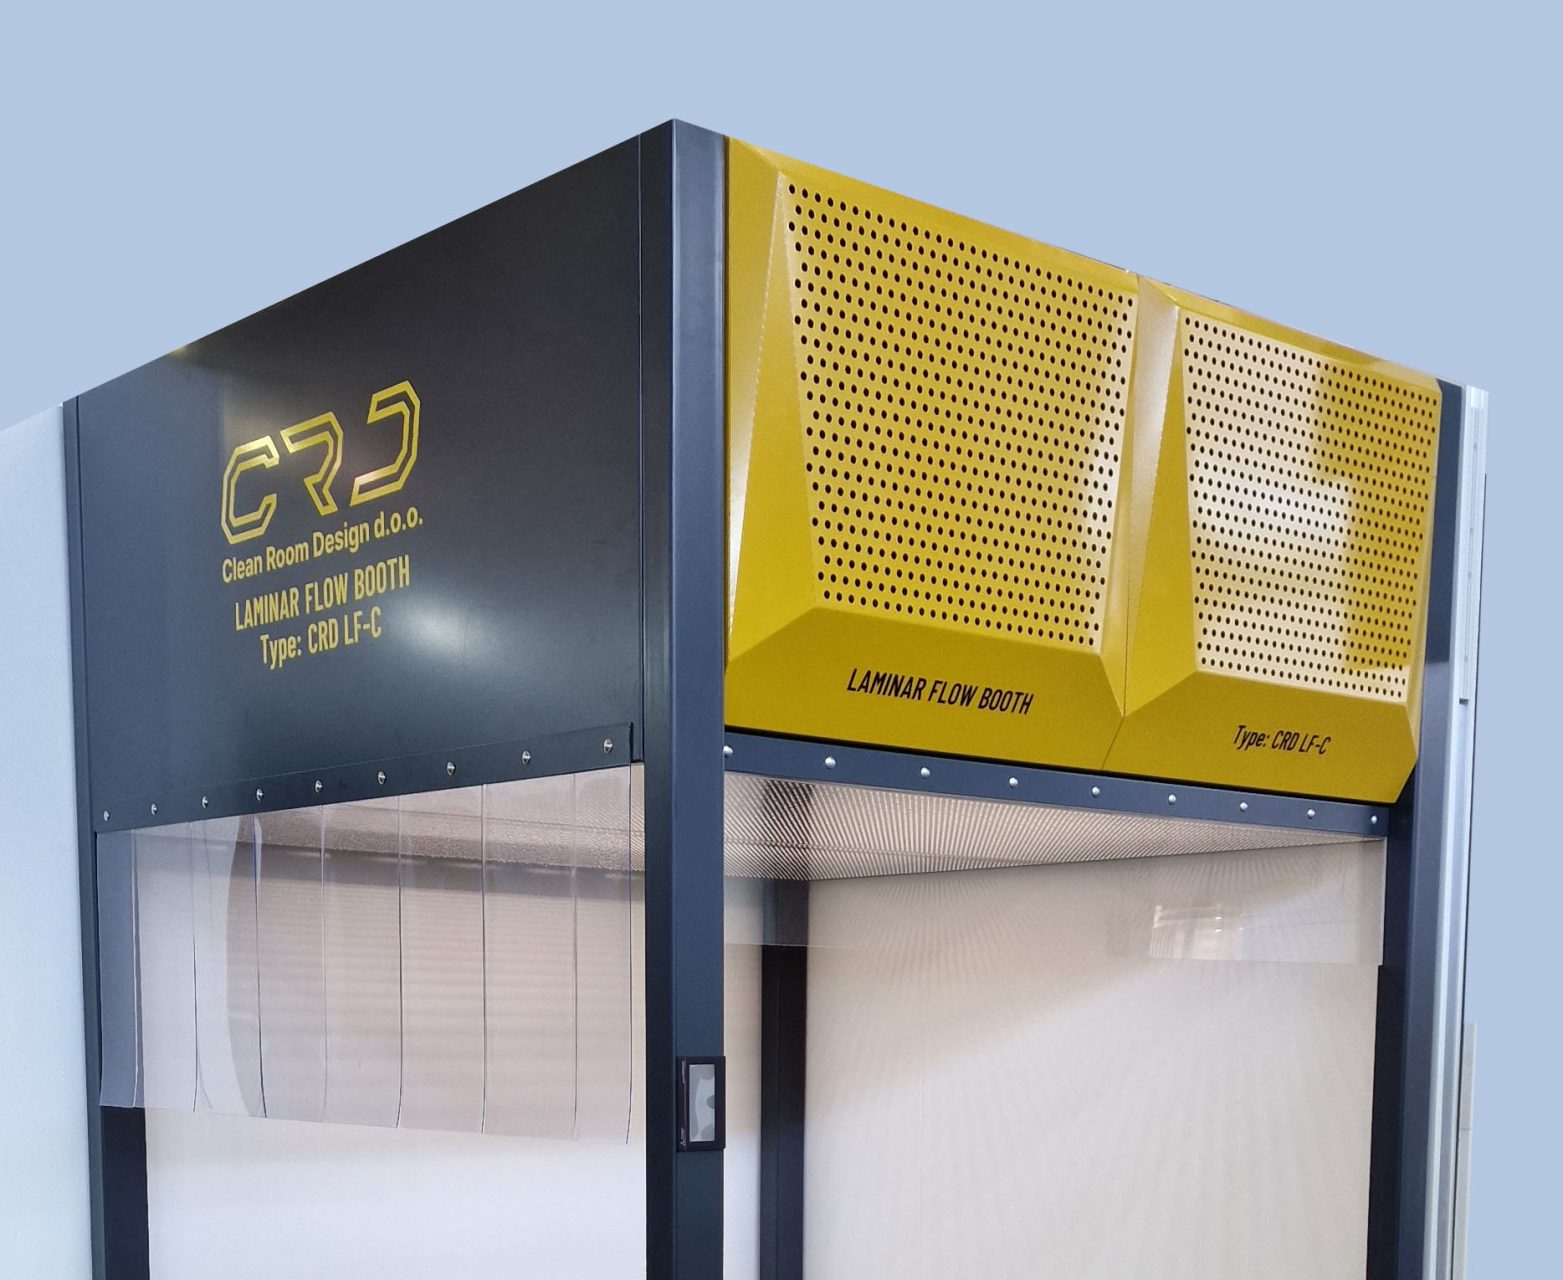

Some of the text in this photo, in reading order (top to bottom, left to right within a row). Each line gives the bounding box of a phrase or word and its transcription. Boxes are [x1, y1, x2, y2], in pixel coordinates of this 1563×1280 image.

[222, 506, 423, 584] Clean Room Design d.o.o.
[235, 554, 410, 631] LAMINAR FLOW BOOTH
[260, 606, 382, 670] Type: CRD LF-C
[847, 668, 1034, 715] LAMINAR FLOW BOOTH
[1233, 725, 1331, 755] Type: CRD LF-C
